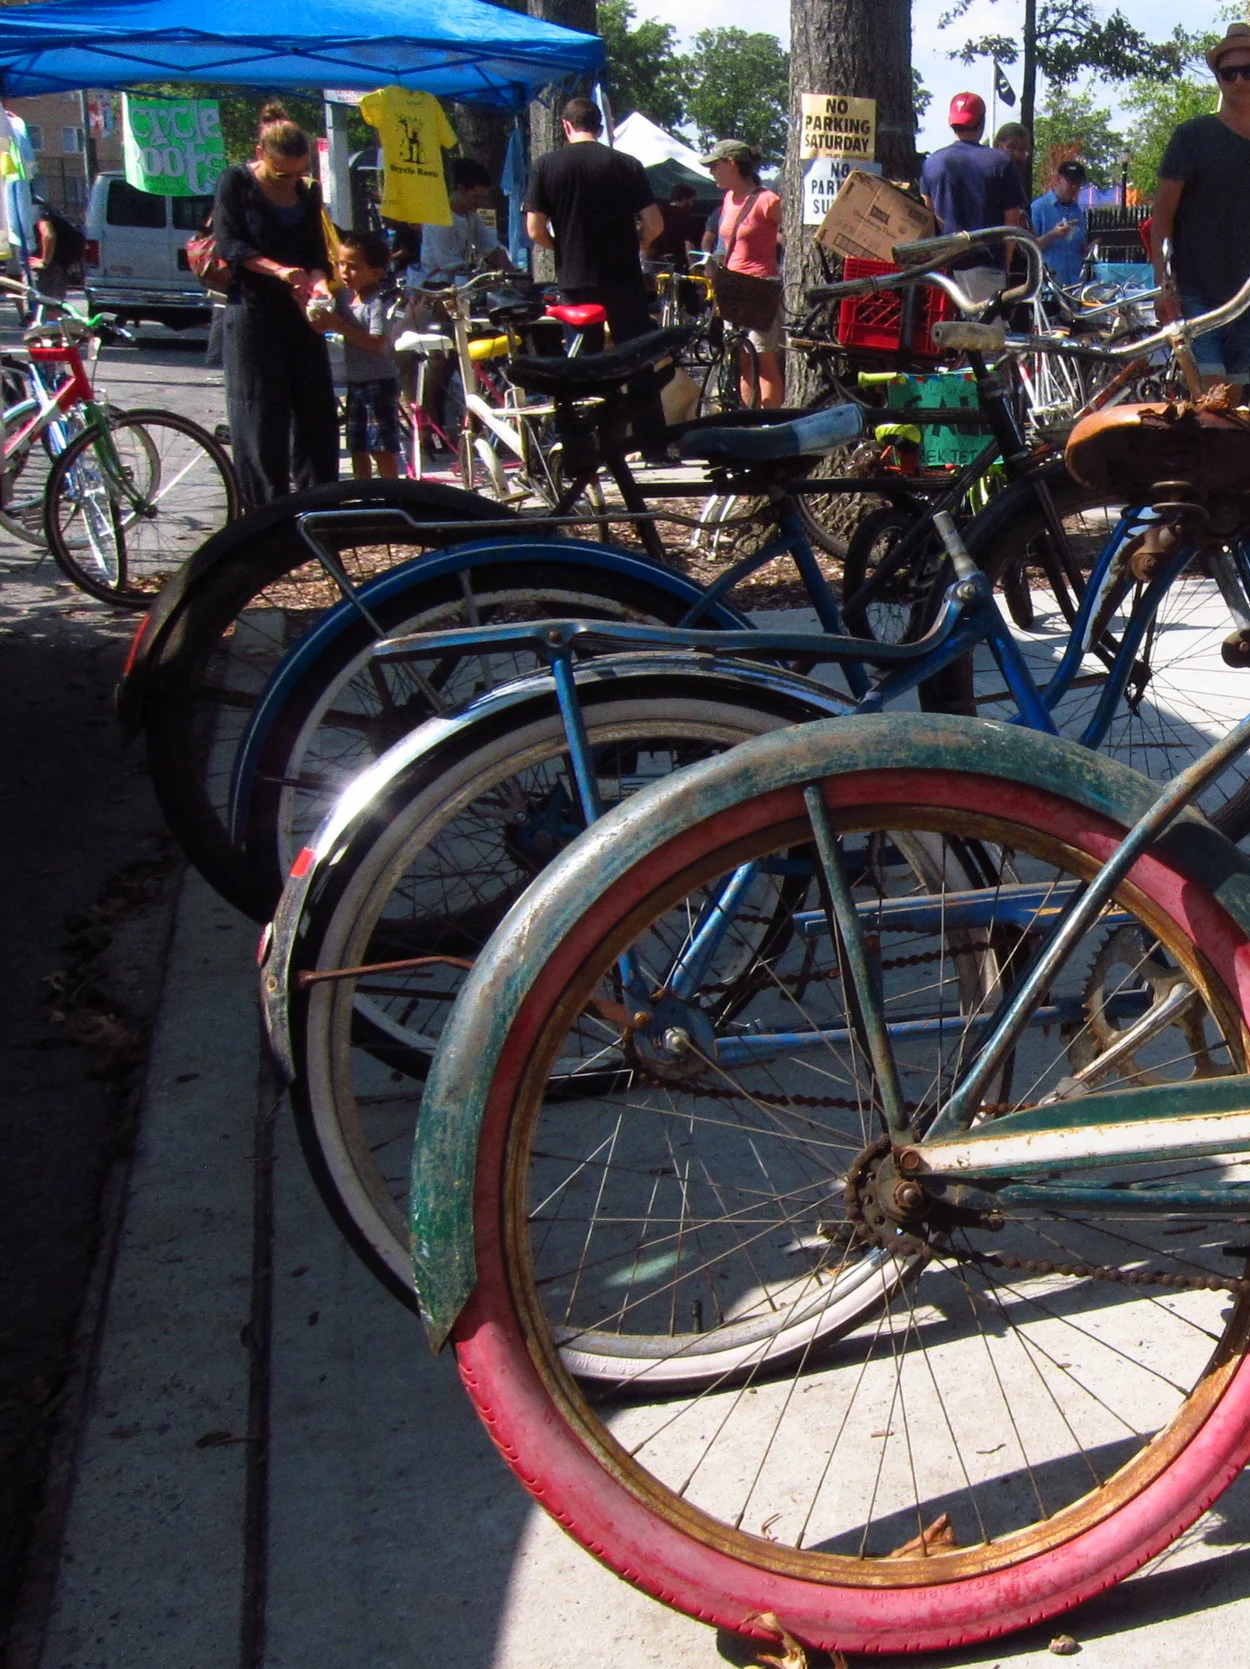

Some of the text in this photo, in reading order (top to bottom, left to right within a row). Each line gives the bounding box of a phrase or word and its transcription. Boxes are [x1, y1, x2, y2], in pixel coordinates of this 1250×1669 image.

[825, 98, 849, 115] NO
[805, 115, 871, 135] PARKING
[804, 133, 869, 153] SATURDAY
[830, 161, 850, 179] NO
[813, 199, 833, 215] SU
